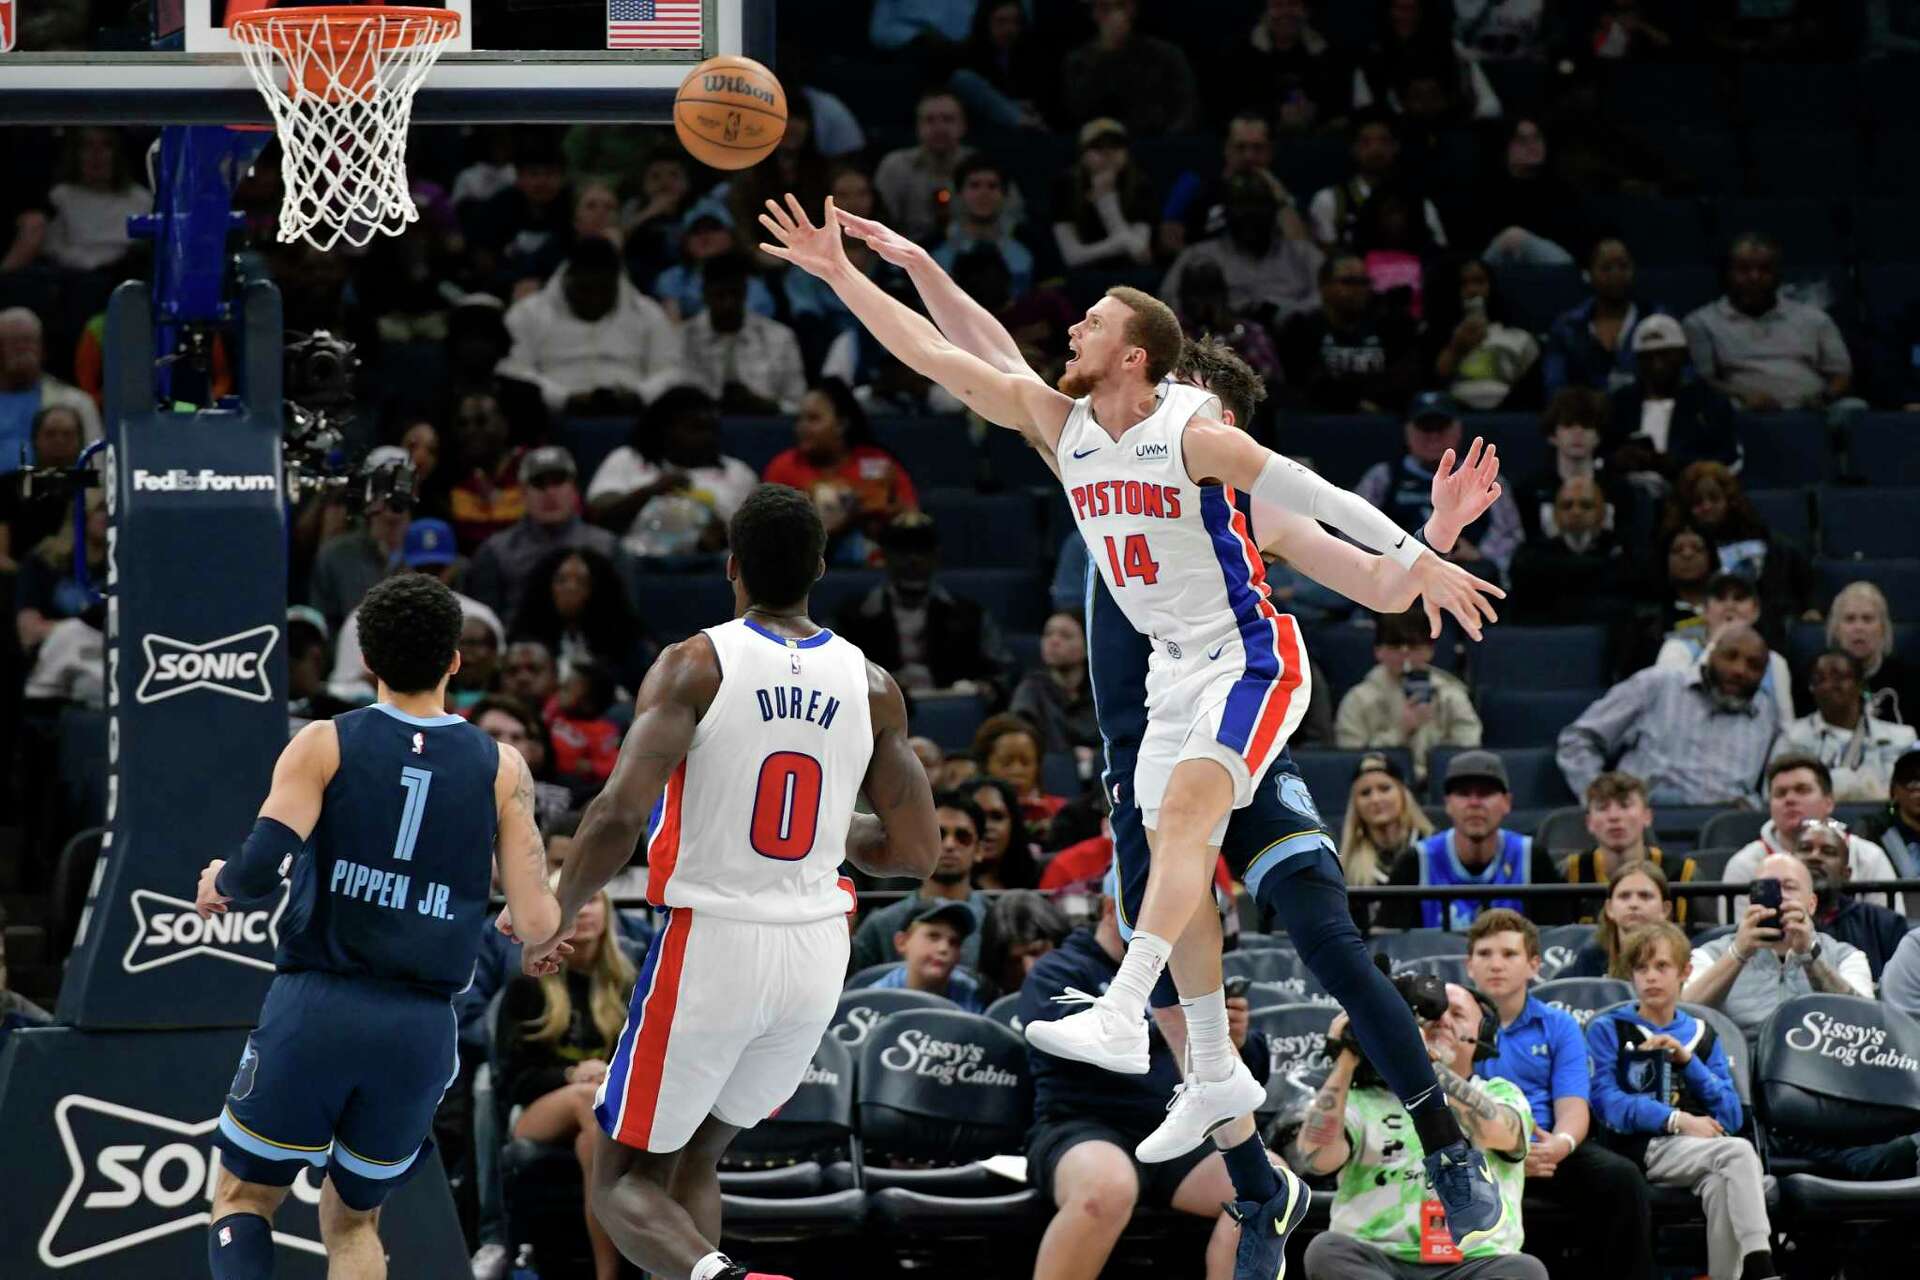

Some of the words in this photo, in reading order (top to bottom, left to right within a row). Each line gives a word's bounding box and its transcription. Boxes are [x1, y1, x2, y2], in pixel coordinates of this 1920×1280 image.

[703, 75, 775, 106] Wilson
[1136, 443, 1168, 456] UWM
[133, 469, 275, 490] FedExForum
[1071, 480, 1181, 520] PISTONS
[1104, 534, 1159, 587] 14
[154, 652, 259, 680] SONIC
[756, 686, 840, 729] DUREN
[750, 750, 823, 861] 0
[330, 859, 411, 910] PIPPEN
[418, 882, 454, 920] JR.
[145, 911, 269, 944] SONIC
[1266, 1032, 1327, 1060] issy's
[1785, 1011, 1887, 1050] Sissy's
[880, 1029, 985, 1071] Sissy's
[1820, 1037, 1859, 1067] Log
[1860, 1045, 1919, 1071] Cabin
[802, 1064, 839, 1086] bin
[915, 1057, 953, 1085] Log
[957, 1062, 1018, 1086] Cabin
